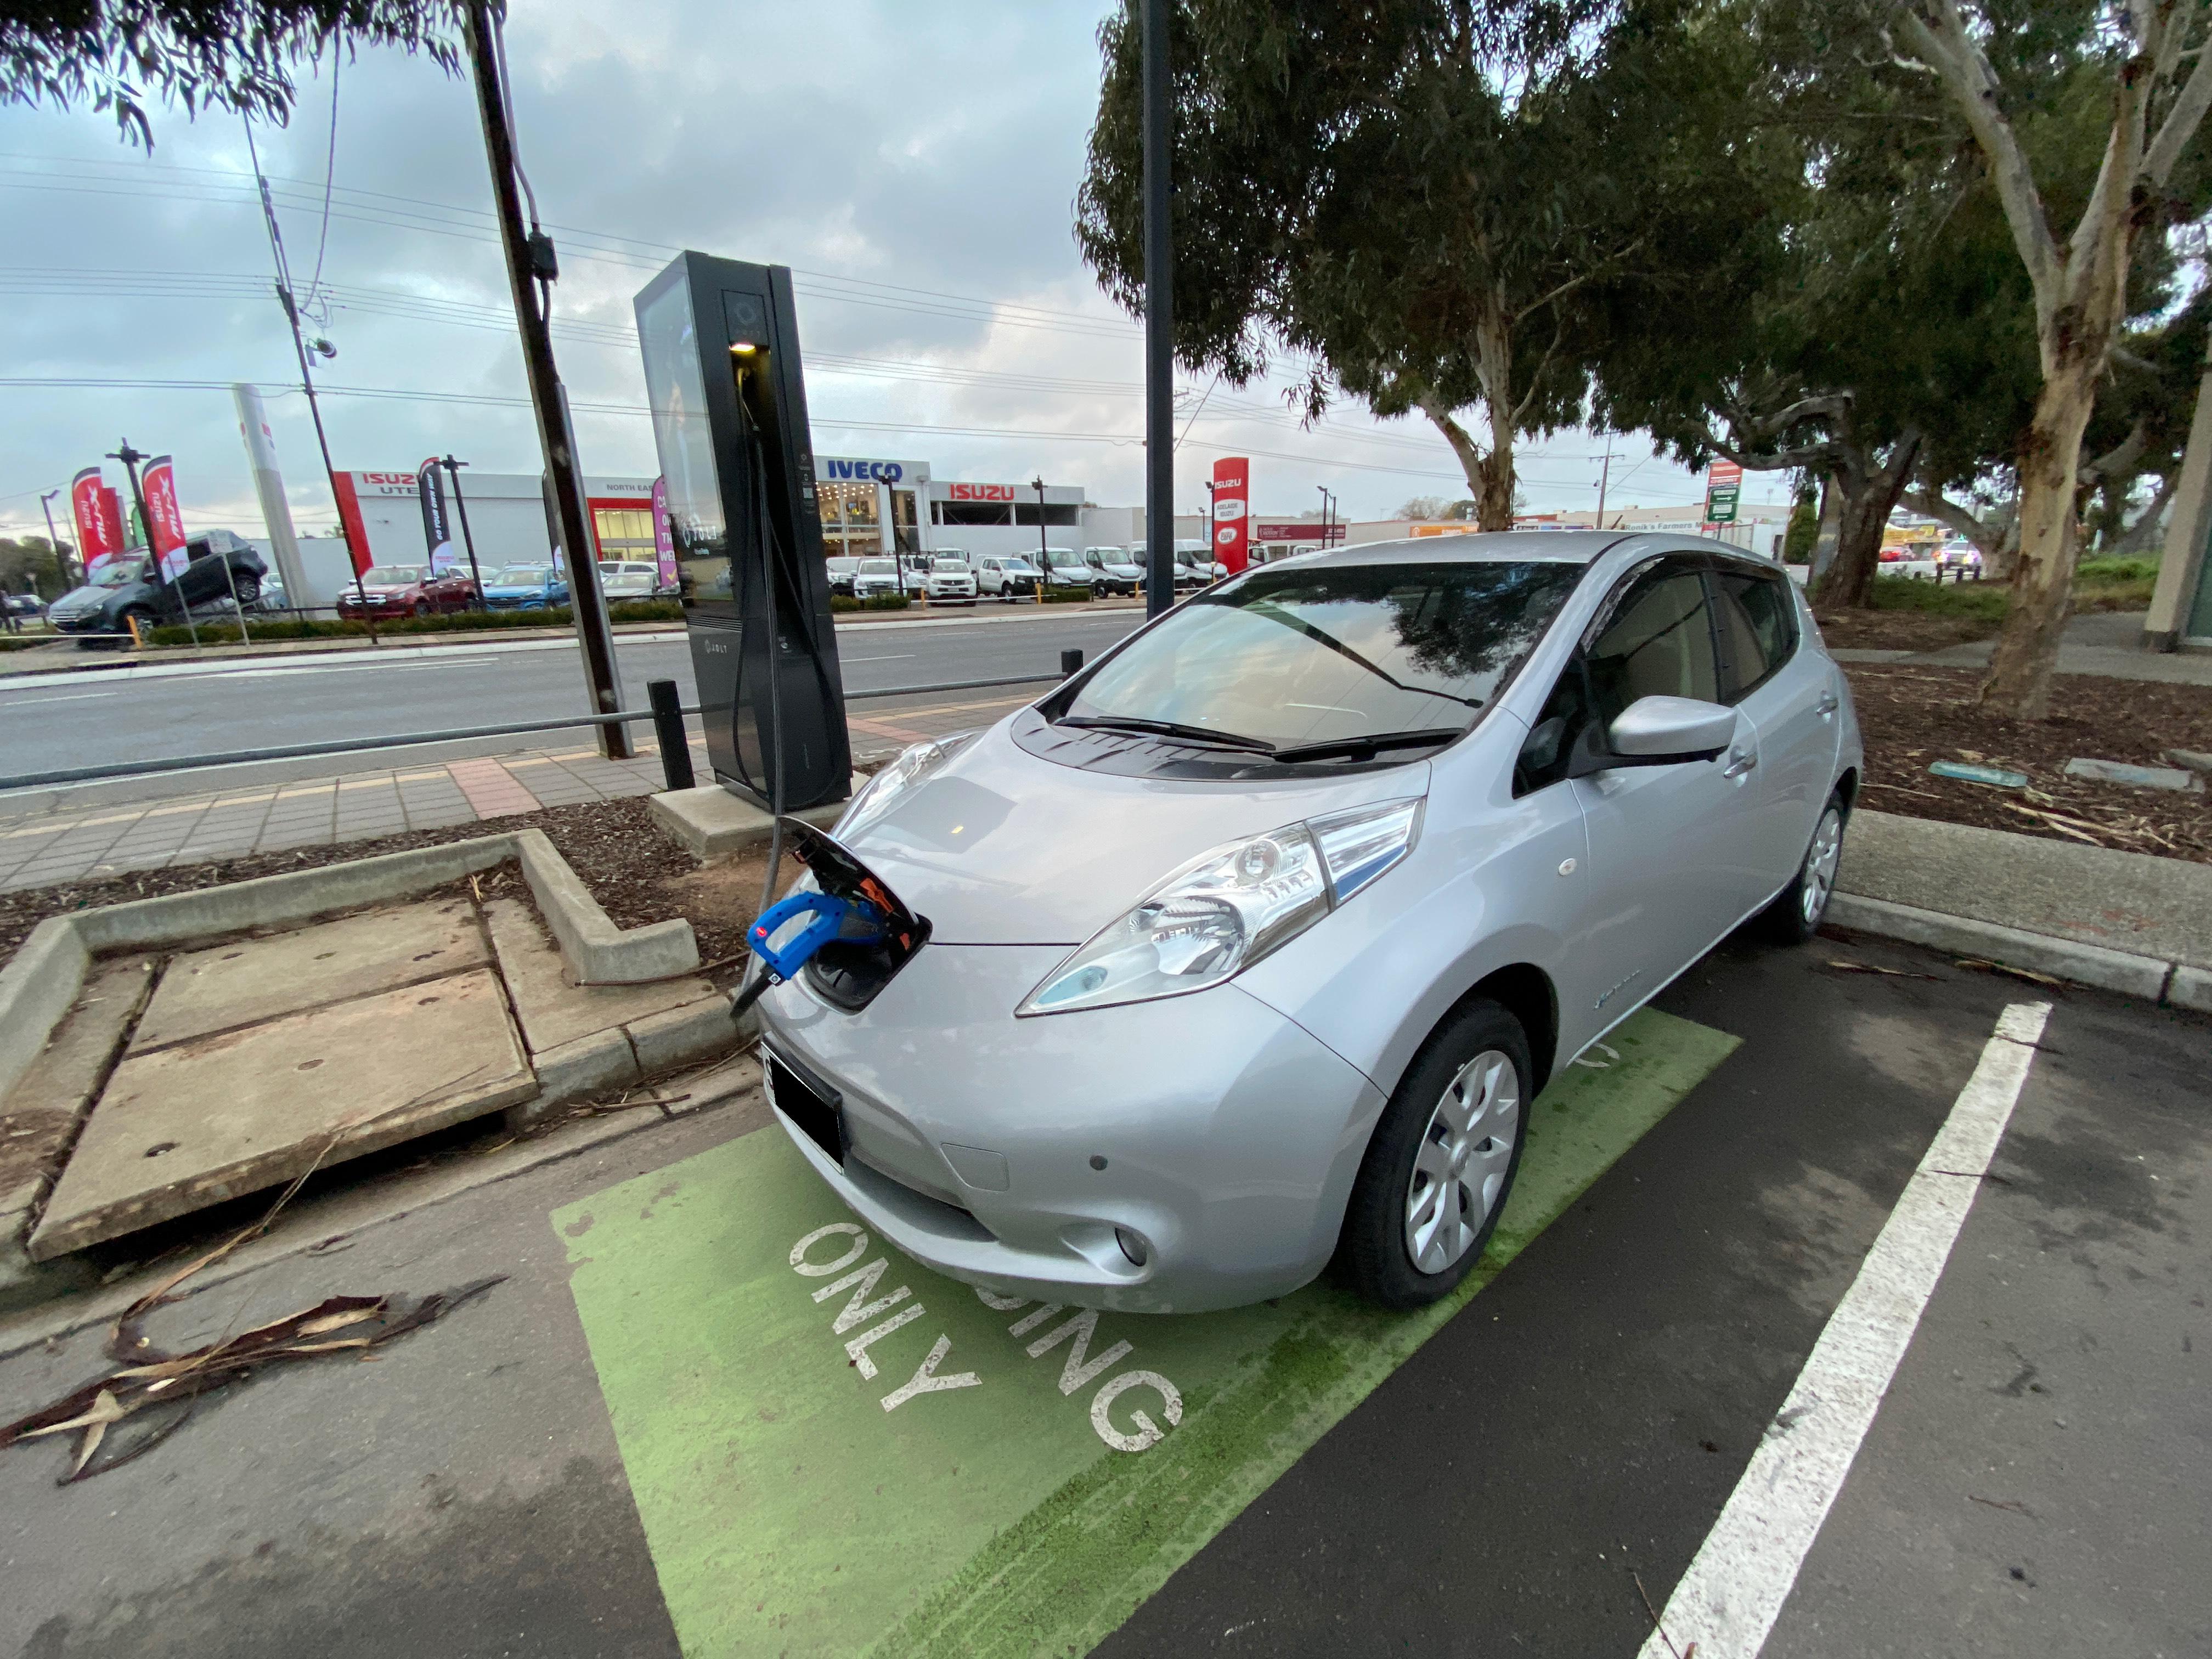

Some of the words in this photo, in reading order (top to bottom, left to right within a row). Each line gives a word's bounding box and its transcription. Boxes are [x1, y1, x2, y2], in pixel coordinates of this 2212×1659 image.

[363, 473, 419, 485] ISUZ
[828, 460, 902, 482] IVECO
[427, 472, 435, 490] WAY
[1214, 478, 1242, 489] ISUZU
[430, 490, 438, 508] OWN
[950, 484, 1015, 501] ISUZU
[151, 492, 165, 522] ISUZU
[657, 495, 667, 509] CA
[80, 500, 93, 529] ISUZU
[432, 509, 441, 528] YOUR
[1658, 522, 1692, 530] Farmers
[436, 530, 443, 540] GO
[661, 532, 673, 544] TH
[789, 1222, 983, 1412] ONLY
